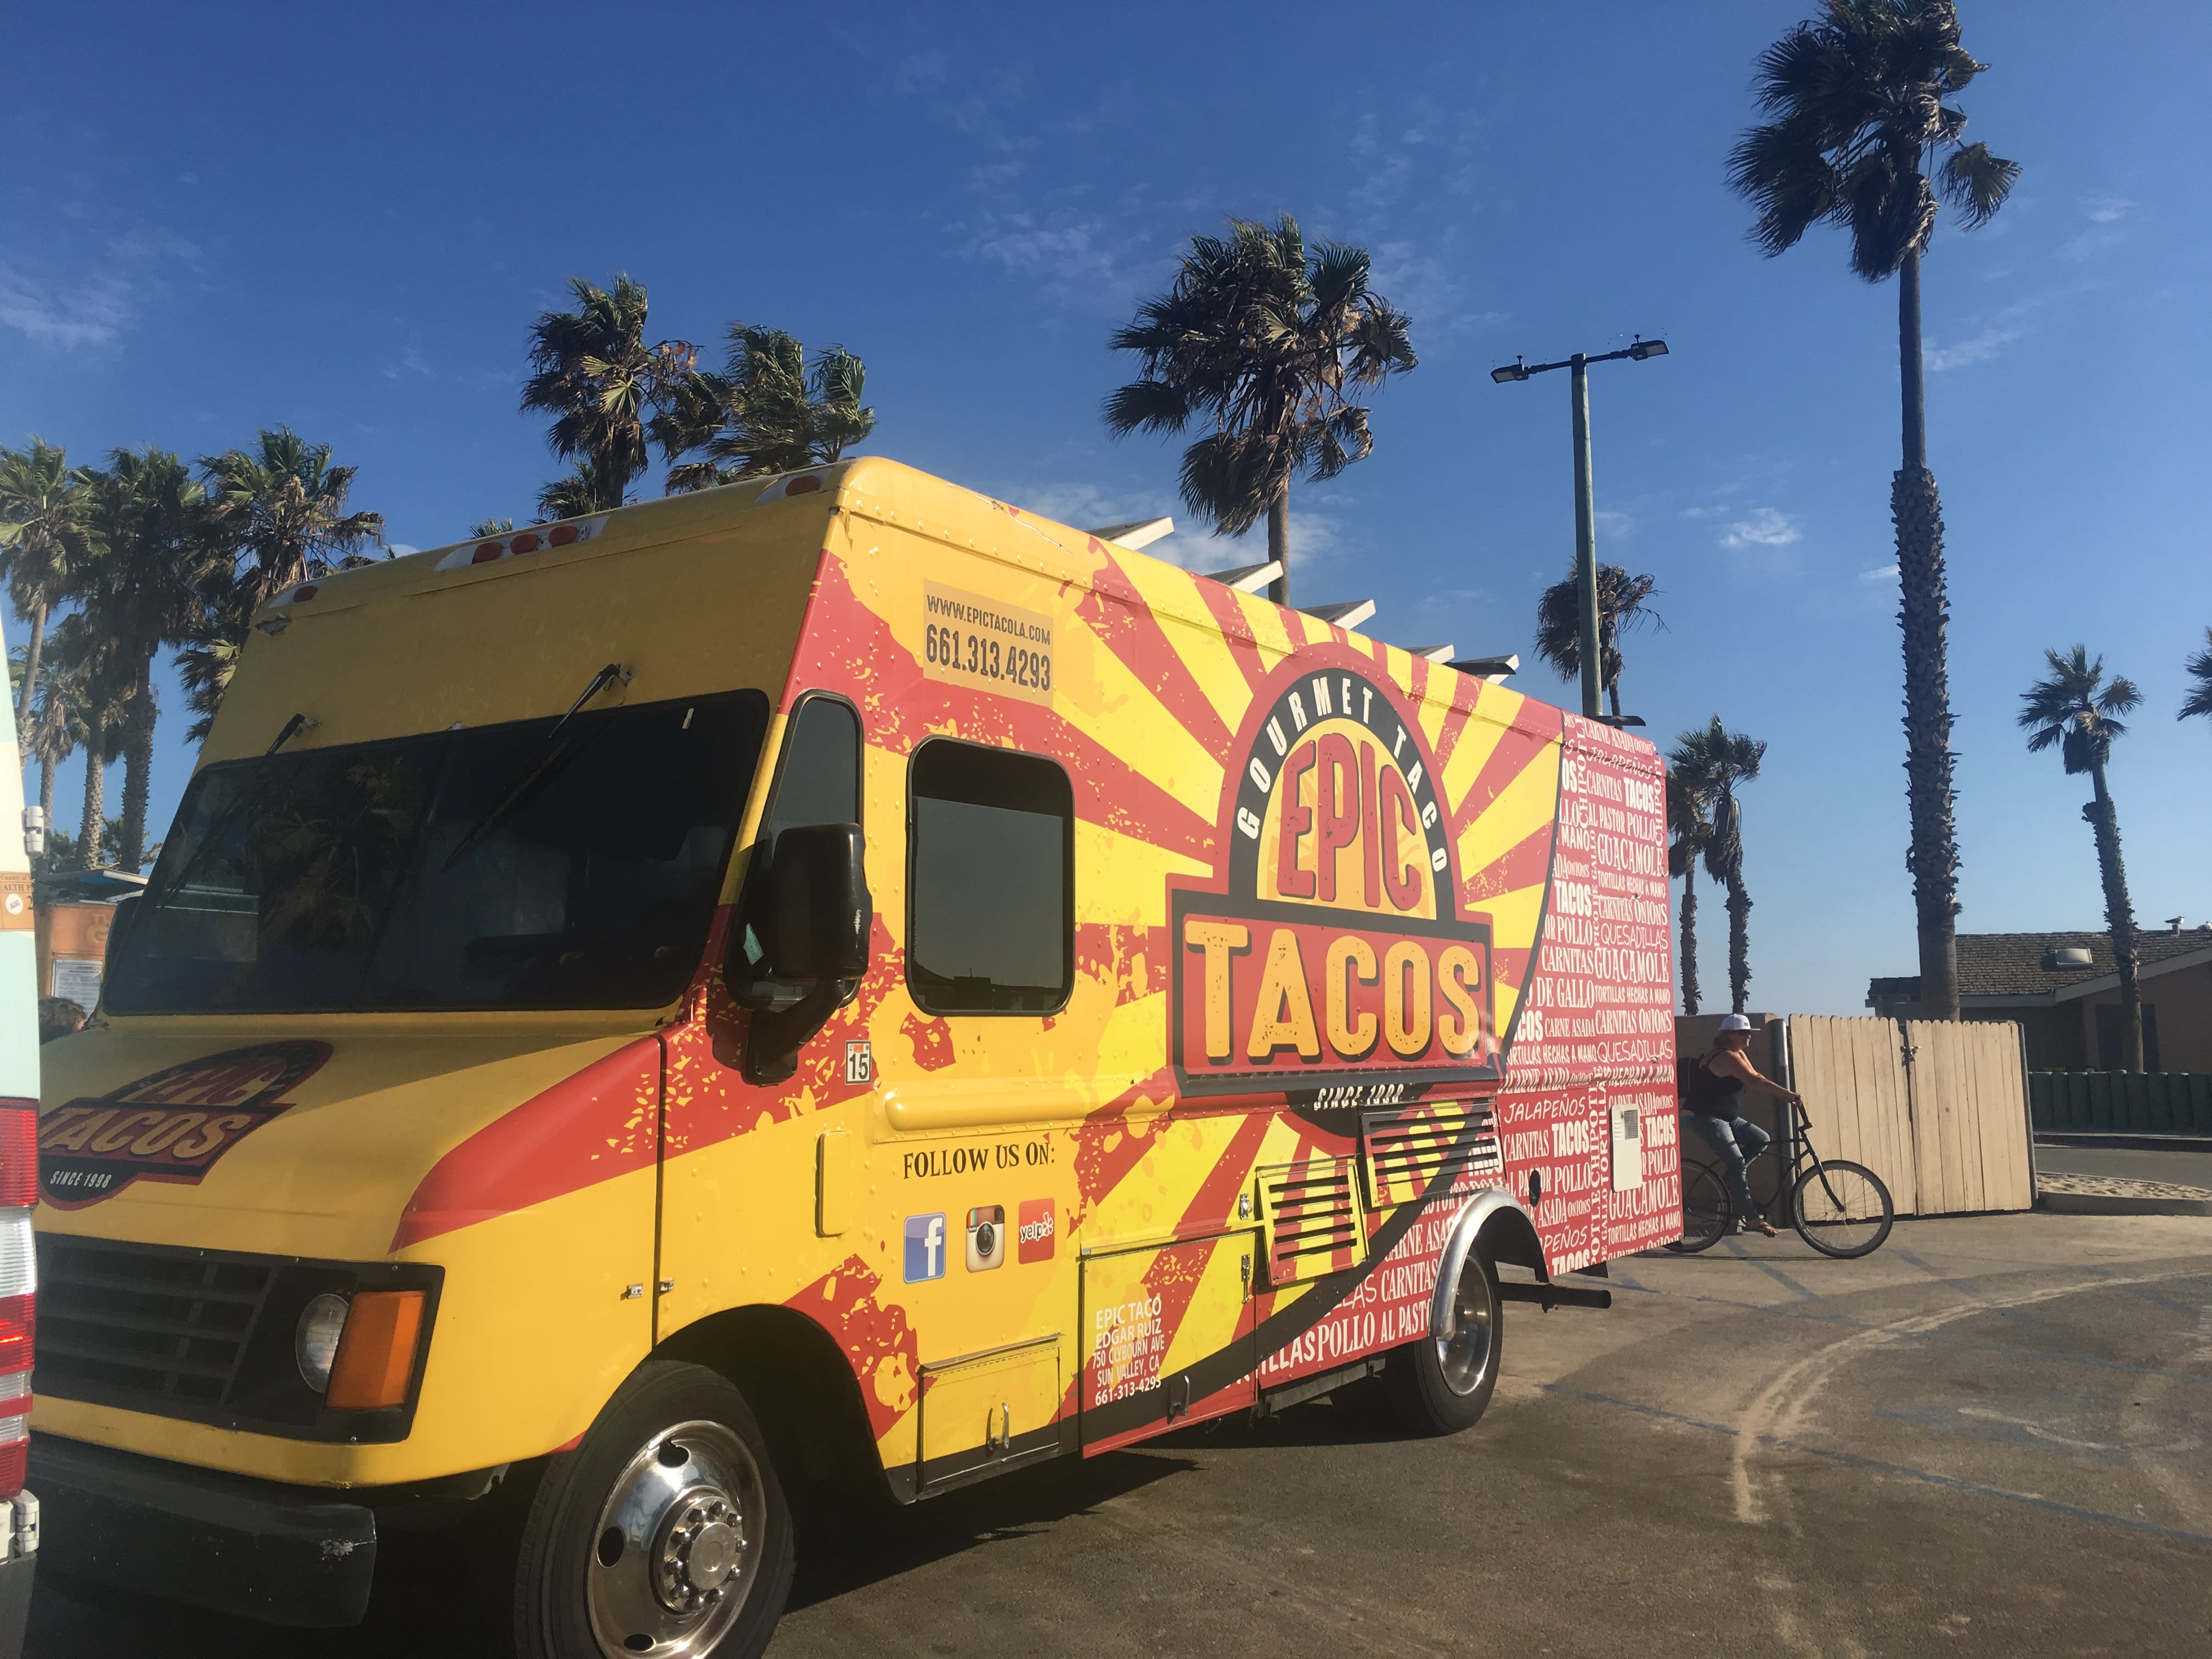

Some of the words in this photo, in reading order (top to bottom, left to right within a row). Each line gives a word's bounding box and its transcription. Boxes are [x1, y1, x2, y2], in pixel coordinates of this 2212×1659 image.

[927, 594, 1050, 645] WWW.EPICTACOLA.COM
[926, 624, 1050, 691] 661.313.4293
[1634, 738, 1653, 756] ONIONS
[1237, 676, 1373, 840] GOURMET
[1393, 724, 1448, 872] TACO
[1586, 770, 1622, 803] CARNITAS
[1623, 776, 1655, 814] TACOS
[1276, 732, 1421, 911] EPIC
[1588, 803, 1598, 827] AL
[1599, 805, 1625, 834] PASTOR
[1627, 811, 1656, 842] POLLO
[1561, 825, 1590, 851] MANO
[1567, 860, 1590, 878] ONIONS
[1597, 833, 1663, 877] GUACAMOLE
[1554, 879, 1592, 917] TACOS
[1598, 870, 1626, 891] TORTILLAS
[1650, 881, 1666, 899] MANO
[1598, 895, 1633, 922] CARNITAS
[1634, 899, 1668, 926] ONIONS
[1557, 915, 1593, 946] POLLO
[1600, 923, 1668, 951] QUESADILLAS
[1542, 945, 1594, 975] CARNITAS
[1594, 946, 1669, 984] GUACAMOLE
[1184, 920, 1481, 1063] TACOS
[1536, 977, 1554, 1007] DE
[1557, 978, 1594, 1009] GALLO
[1595, 985, 1625, 1003] TORTILLAS
[1627, 985, 1648, 1004] HECHAS
[1649, 988, 1654, 1004] A
[1655, 988, 1671, 1005] MANO
[1545, 1018, 1570, 1037] CARNE
[1572, 1017, 1595, 1037] ASADA
[1595, 1010, 1637, 1035] CARNITAS
[1639, 1008, 1672, 1034] ONIONS
[849, 1053, 868, 1079] 15
[1543, 1044, 1570, 1064] HECHAS
[1571, 1045, 1577, 1064] A
[1578, 1044, 1598, 1064] MANO
[1598, 1039, 1673, 1063] QUESADILLAS
[1313, 1086, 1363, 1110] SINCE
[1504, 1093, 1585, 1124] JALAPEÑOS
[1656, 1095, 1673, 1109] ONIONS
[39, 1107, 251, 1159] TACOS
[1504, 1130, 1549, 1163] CARNITAS
[1551, 1120, 1590, 1158] TACOS
[1645, 1114, 1676, 1148] TACOS
[904, 1148, 990, 1180] FOLLOW
[995, 1144, 1019, 1169] US
[1025, 1142, 1055, 1166] ON:
[1649, 1147, 1677, 1176] POLLO
[50, 1171, 81, 1187] SINCE
[83, 1172, 112, 1189] 1998
[1519, 1166, 1551, 1197] PAOR
[1554, 1162, 1591, 1195] POLLO
[1538, 1197, 1568, 1228] ASADA
[1568, 1199, 1591, 1217] ONIONS
[1609, 1175, 1679, 1221] GUACAMOLE
[1020, 1221, 1043, 1244] yelp
[1607, 1223, 1637, 1246] TORTILLAS
[1638, 1216, 1658, 1239] HECHAS
[1660, 1215, 1664, 1233] A
[1666, 1211, 1681, 1231] MANO
[1096, 1305, 1125, 1330] EPIC
[1128, 1296, 1162, 1322] TACO
[1096, 1325, 1134, 1350] EDGAR
[1137, 1318, 1162, 1340] RUIZ
[1109, 1339, 1148, 1364] CLYBOURN
[1150, 1334, 1165, 1353] AVE
[1317, 1311, 1375, 1362] POLLO
[1380, 1310, 1395, 1344] AL
[1097, 1367, 1113, 1387] SUN
[1116, 1358, 1147, 1381] VALLEY,
[1149, 1355, 1160, 1372] CA
[1095, 1374, 1161, 1406] 661-313-4293
